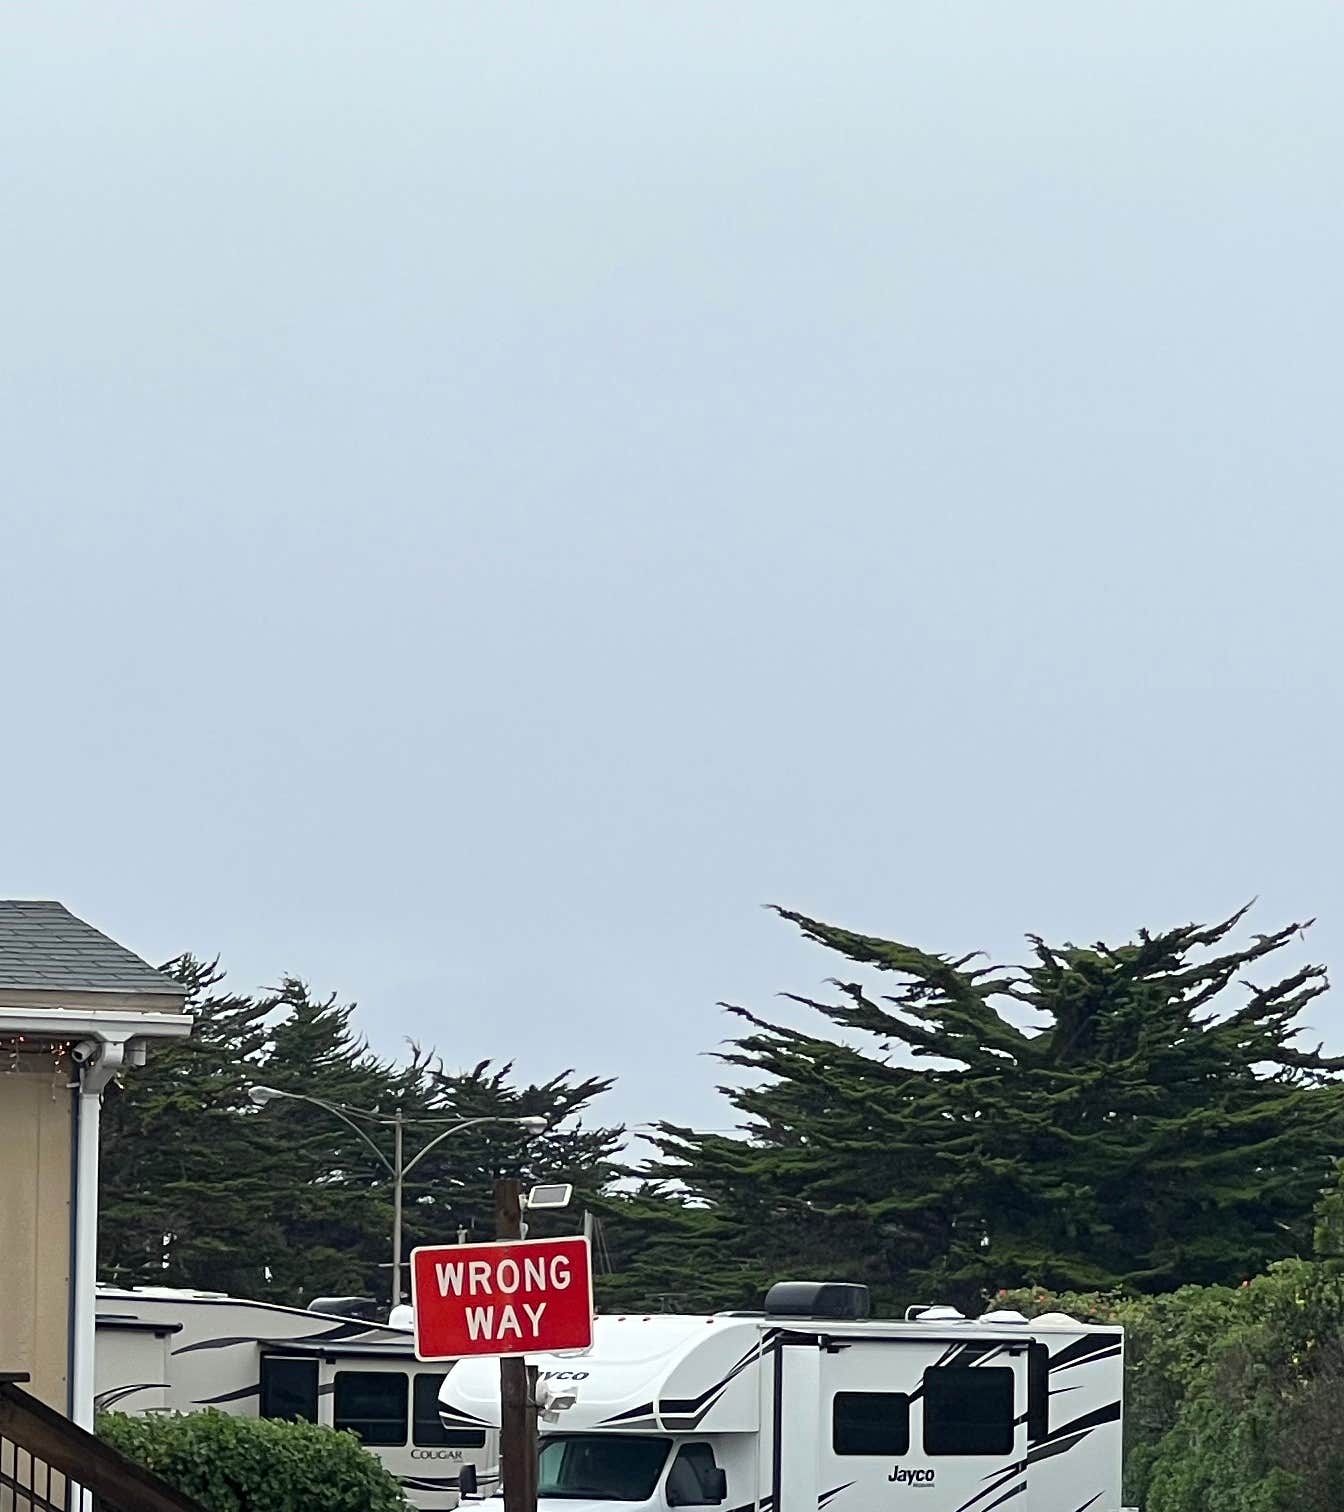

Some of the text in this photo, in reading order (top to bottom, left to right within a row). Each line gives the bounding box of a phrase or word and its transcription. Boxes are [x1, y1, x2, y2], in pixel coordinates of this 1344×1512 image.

[435, 1254, 571, 1297] WRONG
[464, 1302, 547, 1341] WAY
[888, 1465, 935, 1486] Jayco
